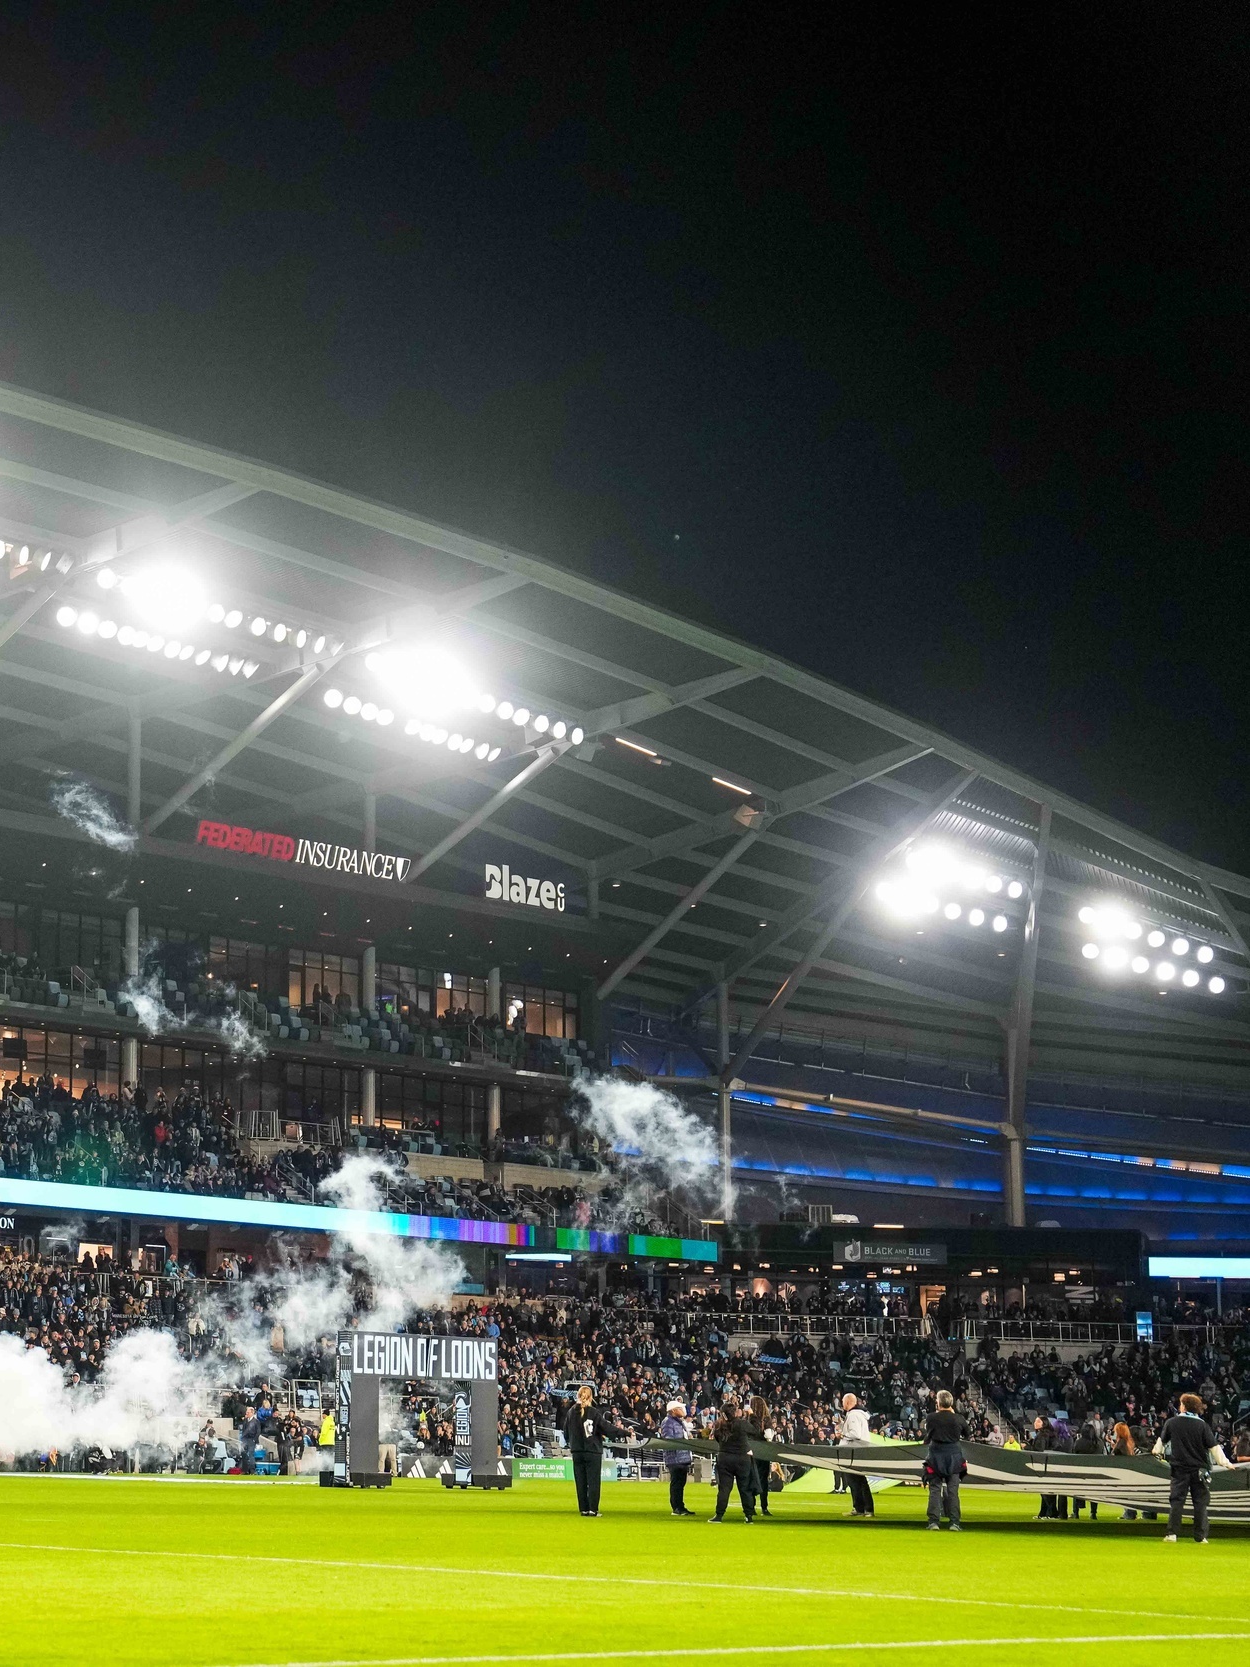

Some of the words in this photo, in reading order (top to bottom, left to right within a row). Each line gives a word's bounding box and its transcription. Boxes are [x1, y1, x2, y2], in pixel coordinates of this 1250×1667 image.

[197, 820, 295, 862] FEDERATED
[295, 838, 395, 880] INSURANCE
[485, 863, 557, 910] Blaze
[864, 1246, 893, 1255] BLACK
[908, 1247, 931, 1256] BLUE
[353, 1334, 413, 1376] LEGION
[417, 1337, 439, 1378] OF
[441, 1339, 496, 1380] LOONS
[519, 1462, 535, 1471] Expert
